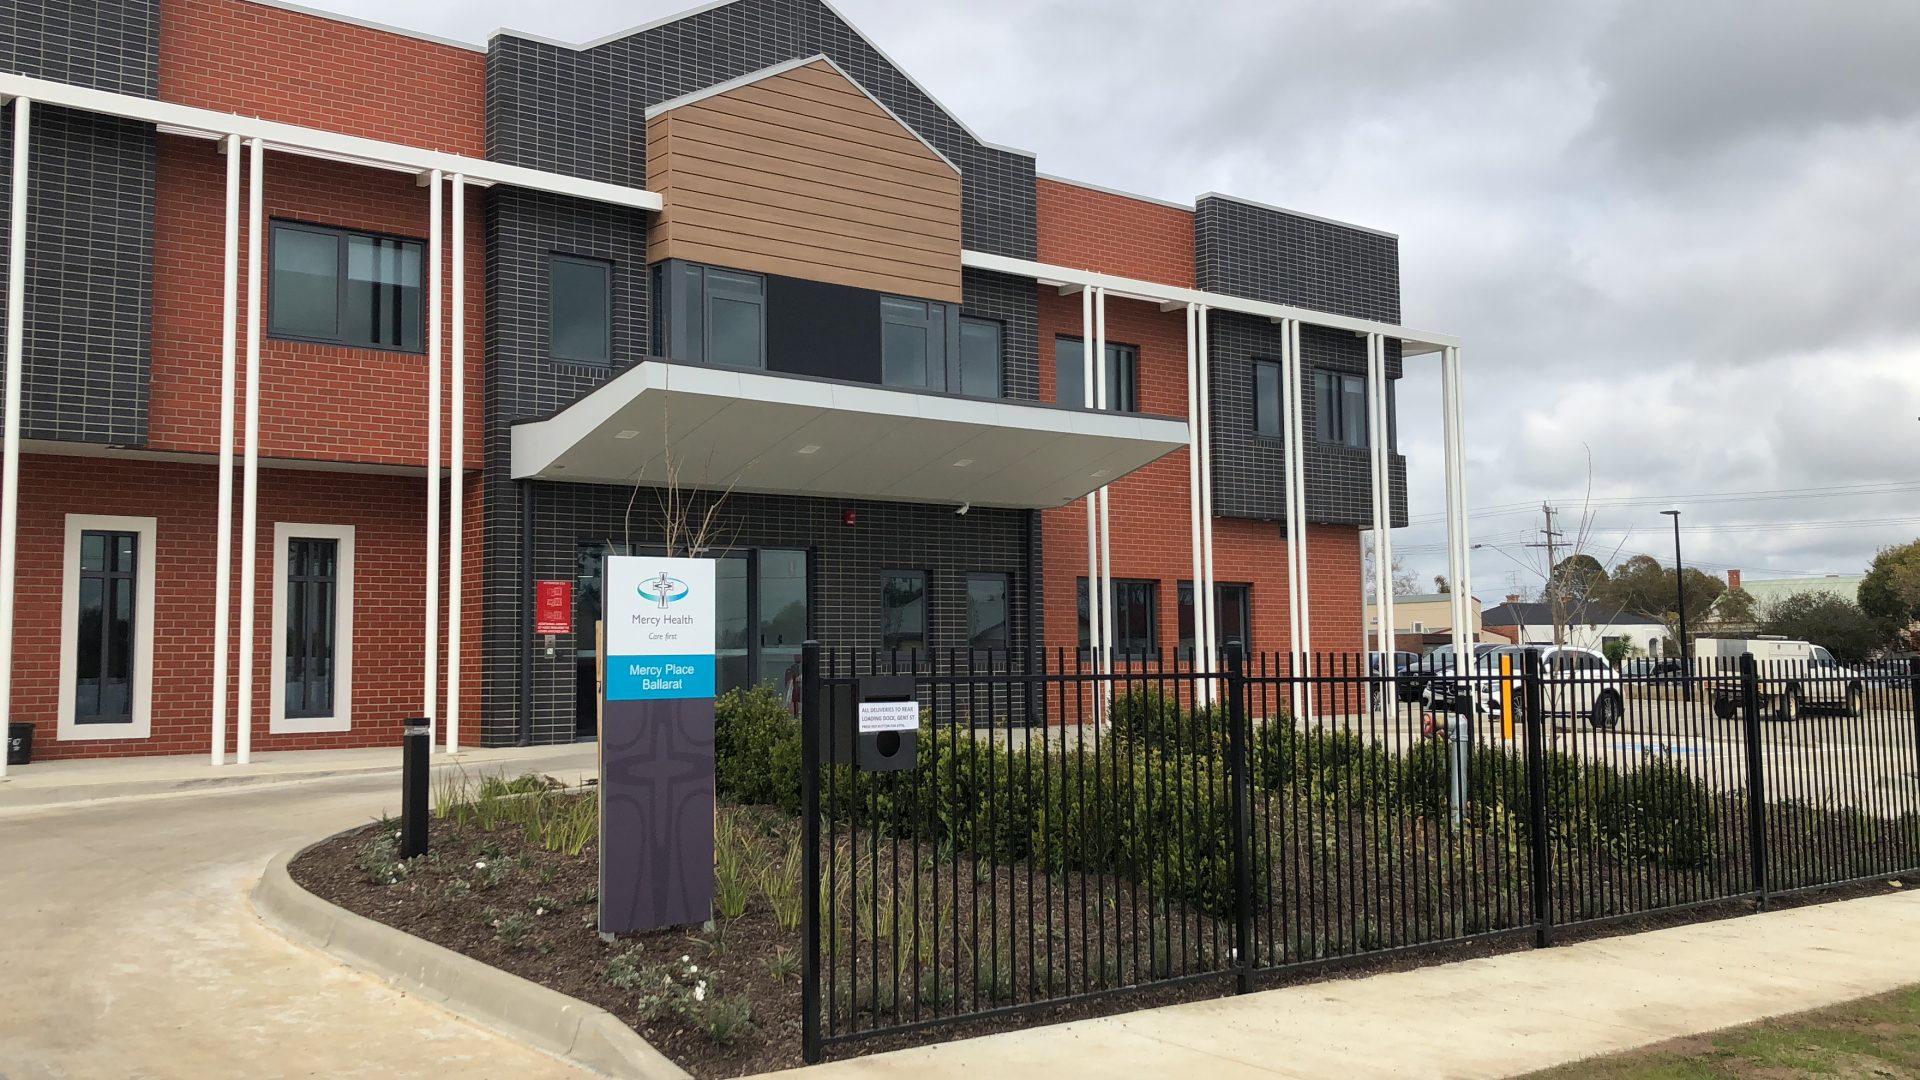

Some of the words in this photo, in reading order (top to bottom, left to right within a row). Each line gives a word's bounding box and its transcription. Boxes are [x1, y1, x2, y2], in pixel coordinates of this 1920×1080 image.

[632, 614, 660, 626] Mercy
[664, 614, 694, 624] Health
[648, 632, 663, 640] Care
[664, 632, 677, 640] first
[630, 664, 662, 678] Mercy
[666, 664, 694, 675] Place
[642, 679, 682, 690] Ballarat
